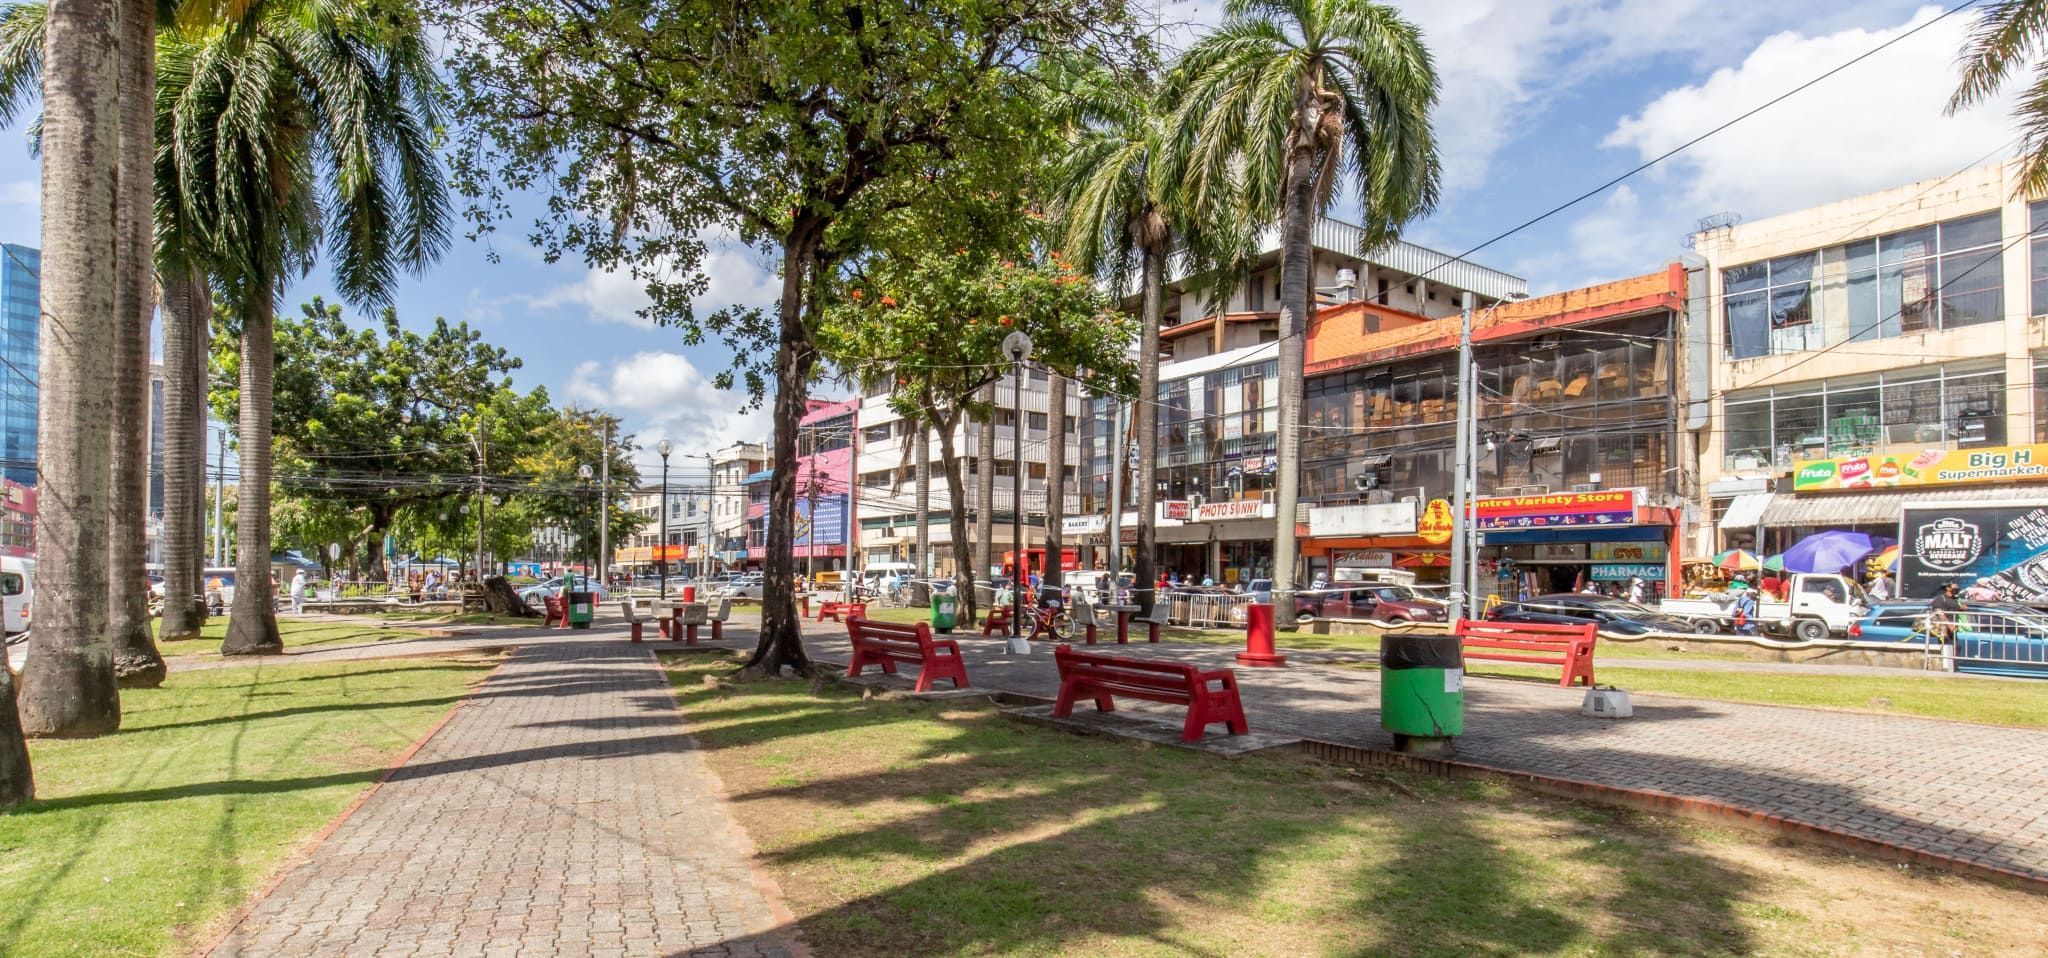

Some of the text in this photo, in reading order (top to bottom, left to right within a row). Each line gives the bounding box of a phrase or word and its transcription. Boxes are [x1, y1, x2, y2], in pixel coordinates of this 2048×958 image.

[1969, 450, 2030, 468] Big H
[1800, 468, 1831, 478] Fruta
[1841, 462, 1868, 473] Fruta
[1939, 465, 2042, 480] Supermarket
[1168, 502, 1188, 510] PHOTO
[1465, 499, 1511, 509] ntre
[1514, 494, 1572, 507] Variety
[1577, 492, 1625, 504] Store
[1200, 501, 1260, 517] PHOTO SONNY
[1924, 533, 1973, 549] MALT
[1613, 548, 1643, 559] CVS
[1592, 566, 1664, 577] PHARMACY
